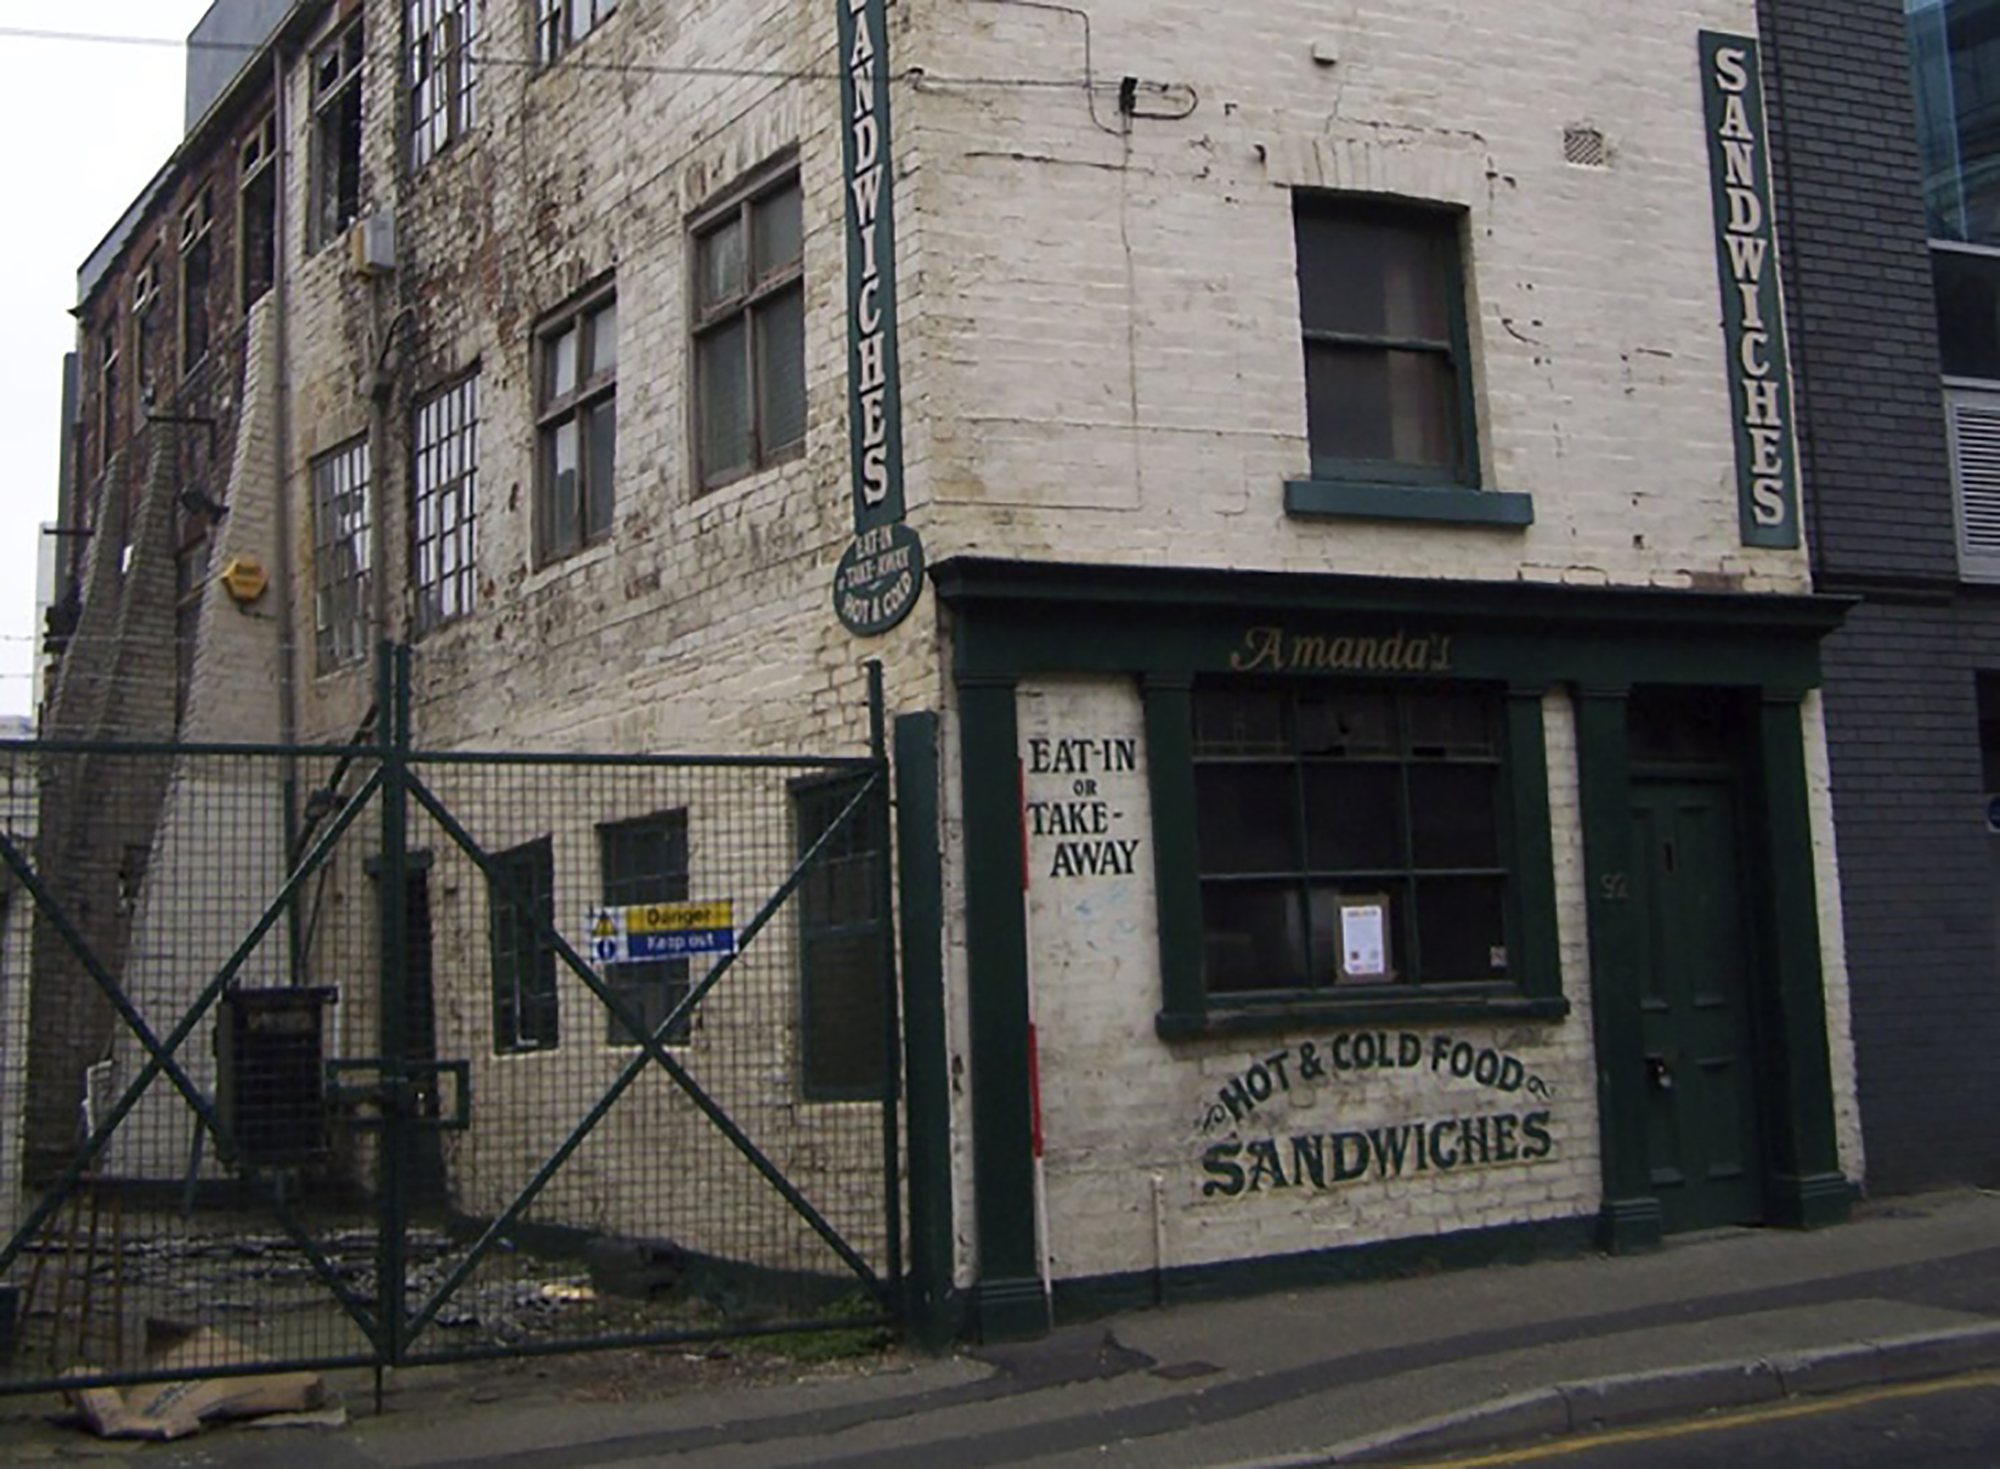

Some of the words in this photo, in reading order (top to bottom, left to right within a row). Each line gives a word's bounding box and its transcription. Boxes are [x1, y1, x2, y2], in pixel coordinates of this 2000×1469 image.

[848, 0, 888, 505] ANDWICHES
[1715, 47, 1785, 526] SANDWICHES
[1229, 626, 1453, 671] Amanda's
[1028, 738, 1136, 774] EAT-IN
[1073, 779, 1097, 797] OR
[1027, 802, 1124, 836] TAKE-
[1050, 839, 1140, 878] AWAY
[647, 907, 711, 926] Danger
[647, 936, 686, 951] Keep
[688, 933, 715, 948] out
[1218, 1051, 1292, 1121] HOT
[1300, 1042, 1326, 1081] &
[1332, 1032, 1421, 1071] COLD
[1431, 1035, 1525, 1093] FOOD
[1203, 1110, 1552, 1198] SANDWICHES
